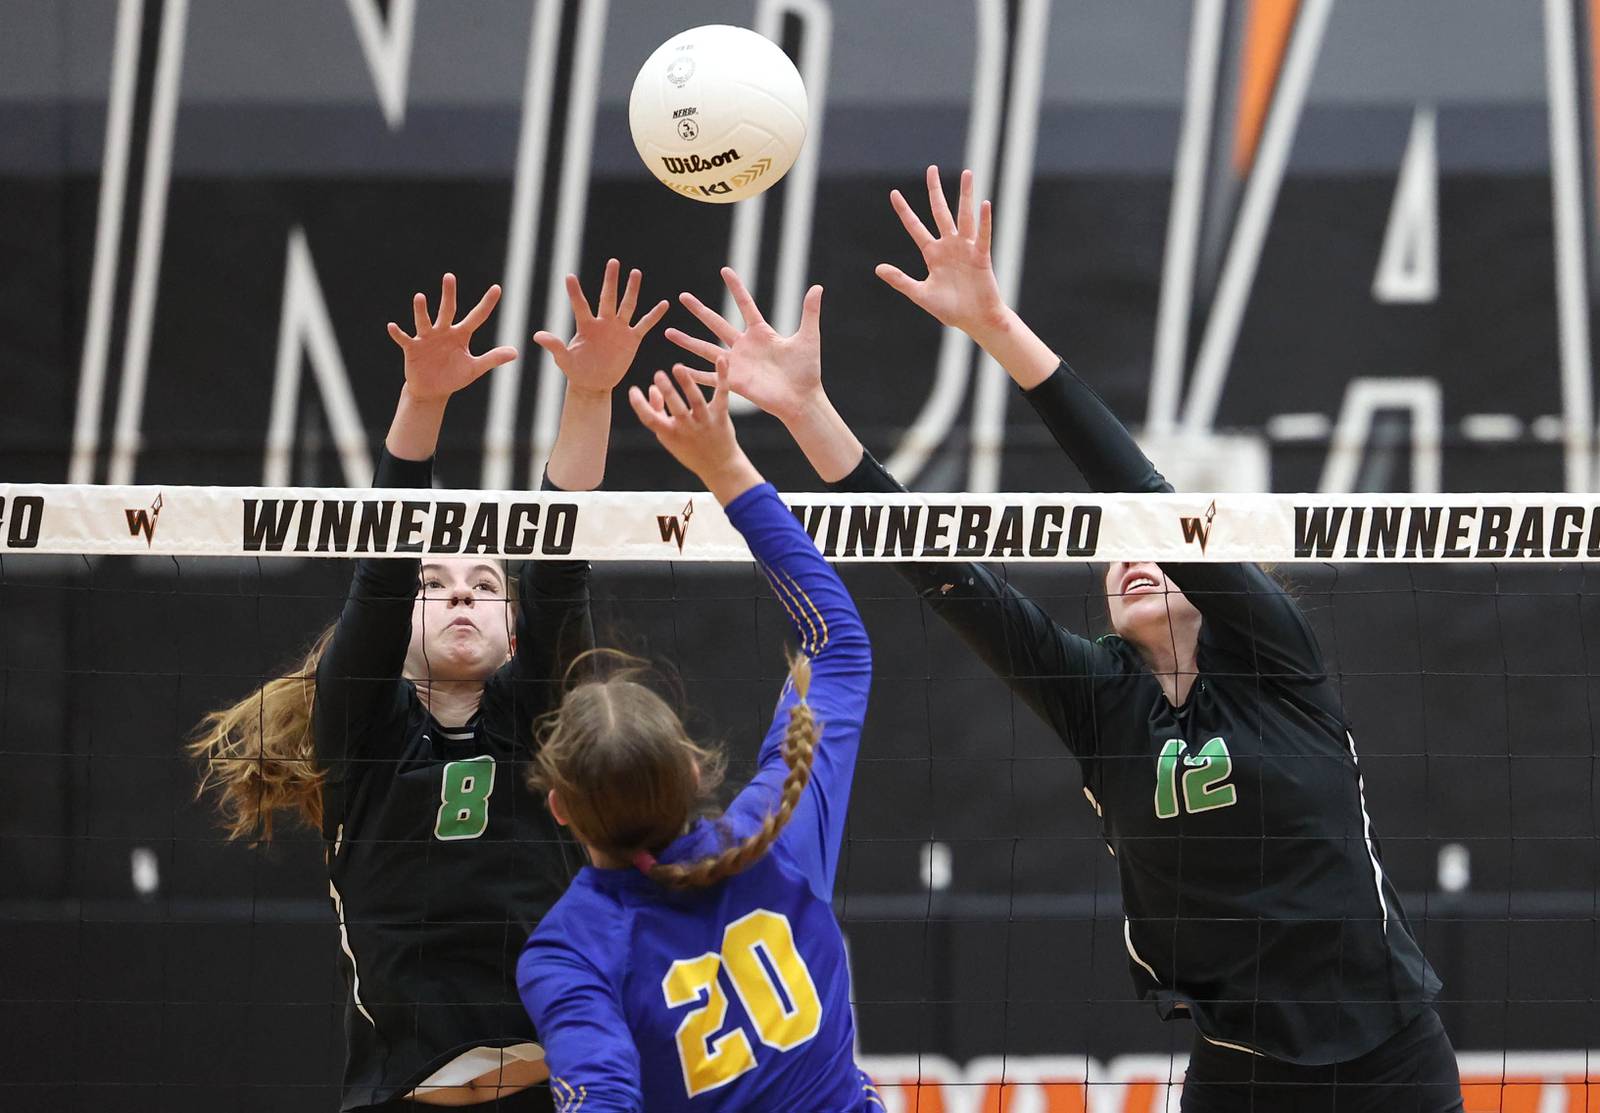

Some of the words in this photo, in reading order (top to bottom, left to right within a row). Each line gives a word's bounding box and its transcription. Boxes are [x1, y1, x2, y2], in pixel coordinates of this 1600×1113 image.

[661, 149, 741, 174] Wilson
[0, 496, 45, 548] O
[242, 499, 578, 555] WINNEBAGO
[434, 754, 496, 841] 8
[1154, 737, 1237, 819] 12
[662, 908, 823, 1099] 20
